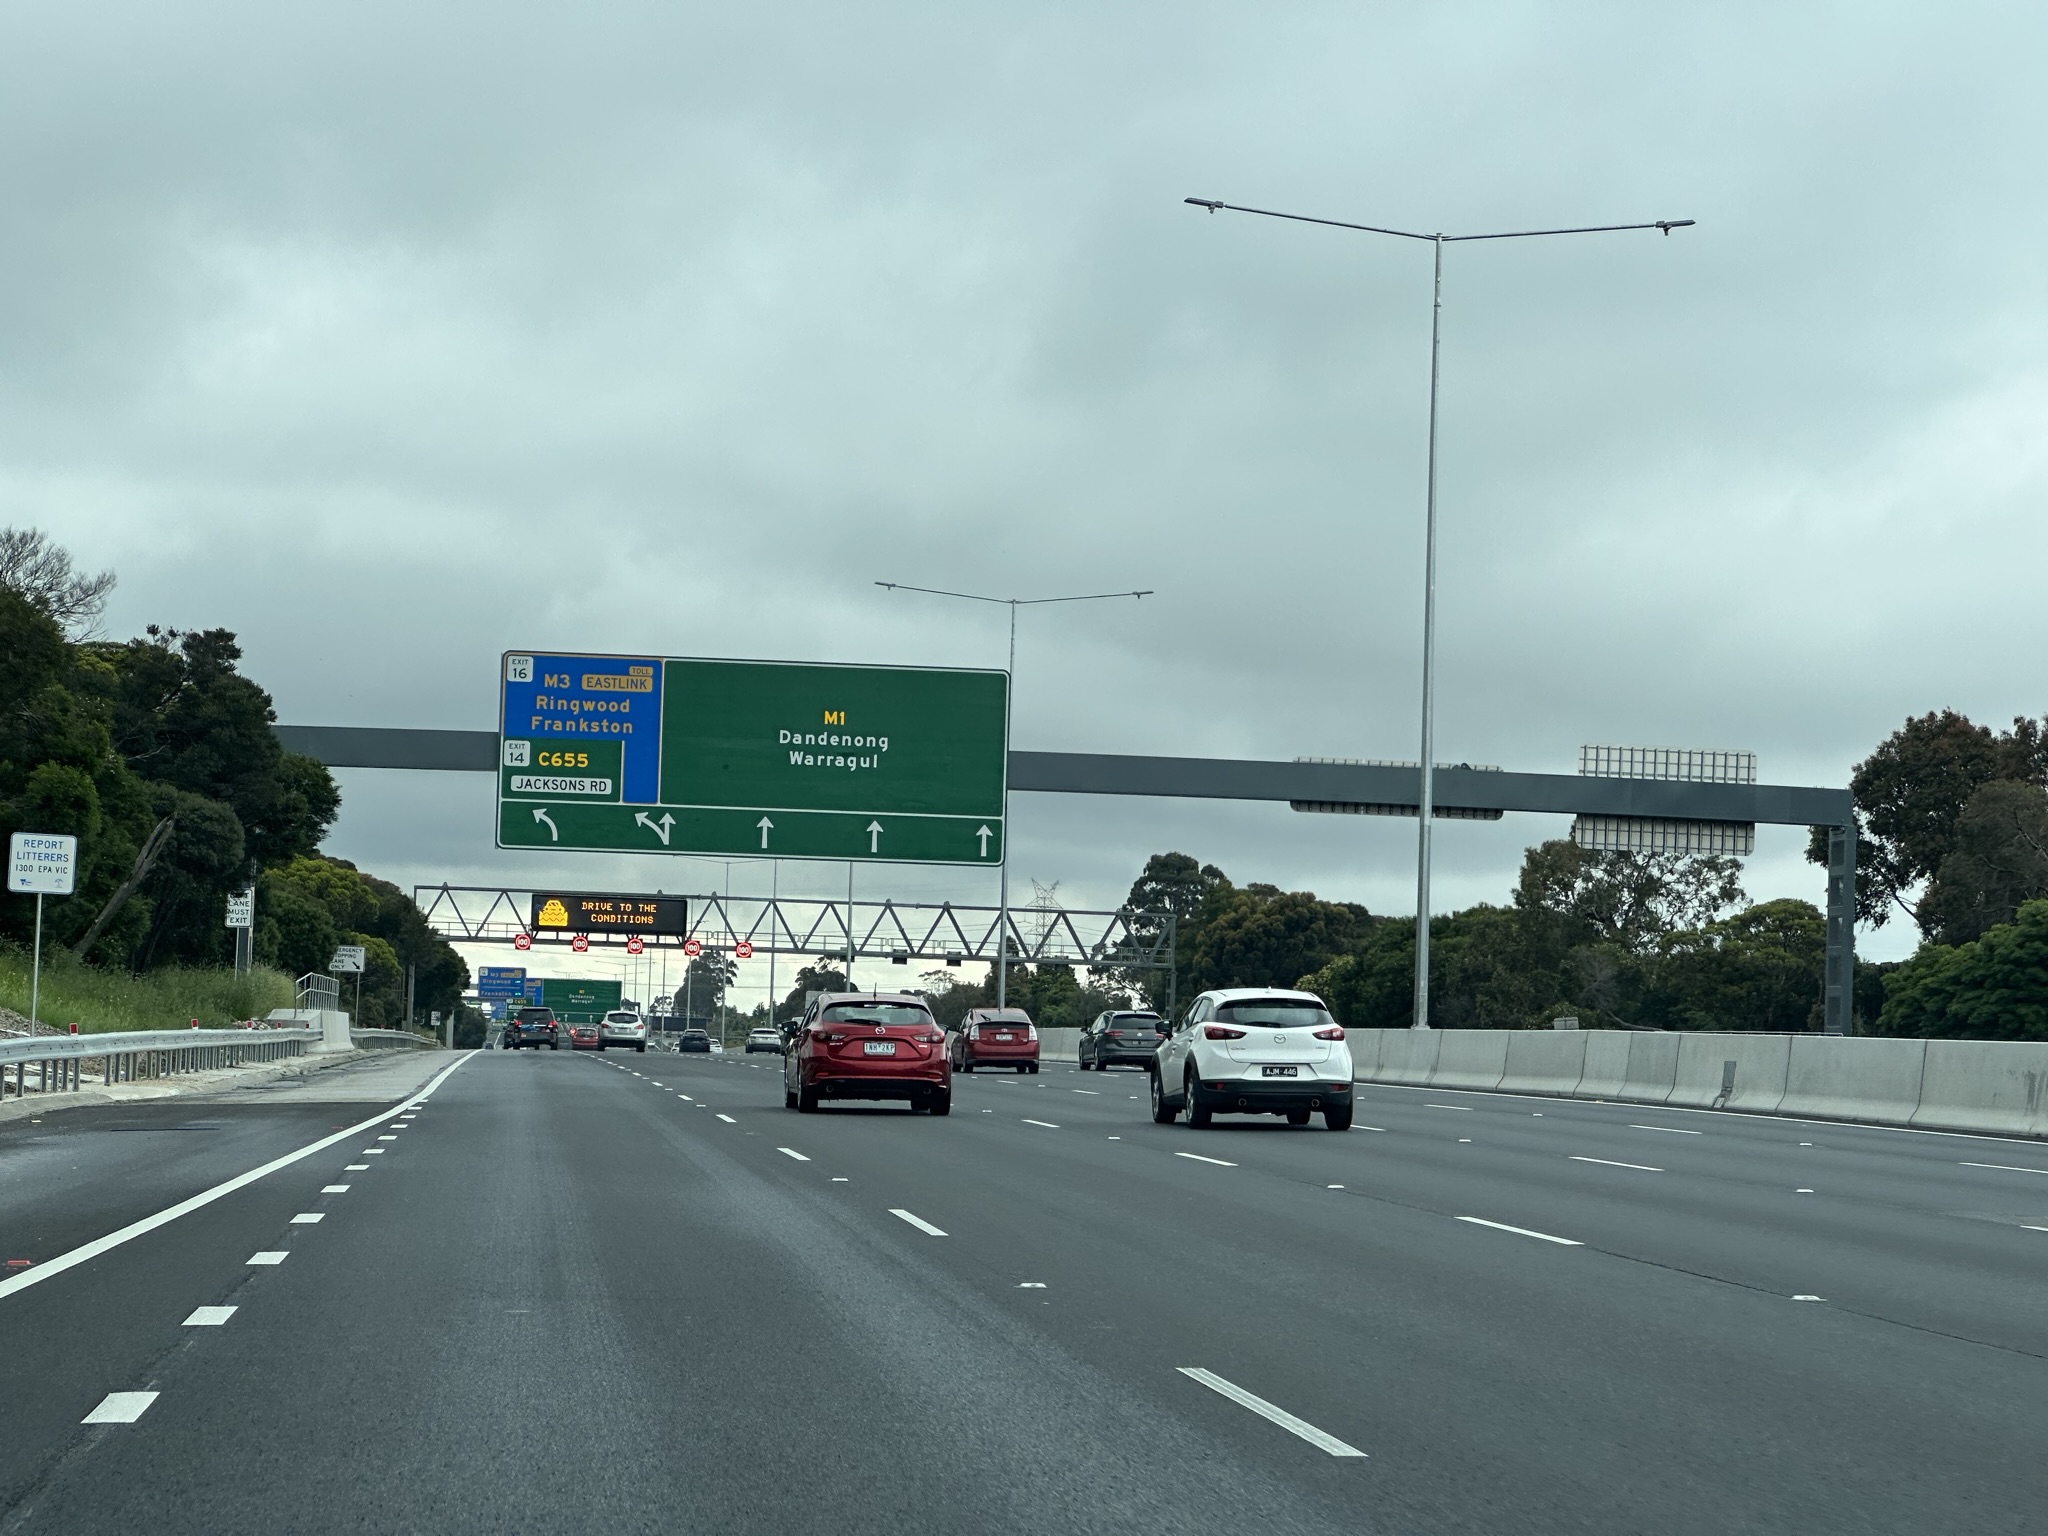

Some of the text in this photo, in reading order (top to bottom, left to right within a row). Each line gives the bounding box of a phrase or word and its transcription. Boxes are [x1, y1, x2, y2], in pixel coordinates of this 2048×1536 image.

[513, 668, 527, 679] 16
[544, 674, 648, 690] M3 EASTLINK
[536, 696, 630, 715] Ringwood
[824, 711, 845, 725] M1
[531, 716, 633, 734] Frankston
[779, 730, 888, 752] Dandenong
[510, 752, 524, 763] 14
[538, 752, 589, 768] C655
[789, 751, 878, 771] Warragul
[516, 778, 607, 792] JACKSONS RD
[24, 839, 64, 850] REPORT
[16, 851, 69, 862] LITTERERS
[15, 864, 68, 874] 1300 EPA VIC
[582, 902, 657, 913] DRIVE TO THE
[591, 914, 655, 924] CONDITIONS
[517, 938, 528, 946] 100
[575, 939, 586, 948] 100
[630, 941, 640, 950] 100
[687, 944, 698, 952] 100
[739, 946, 749, 954] 100
